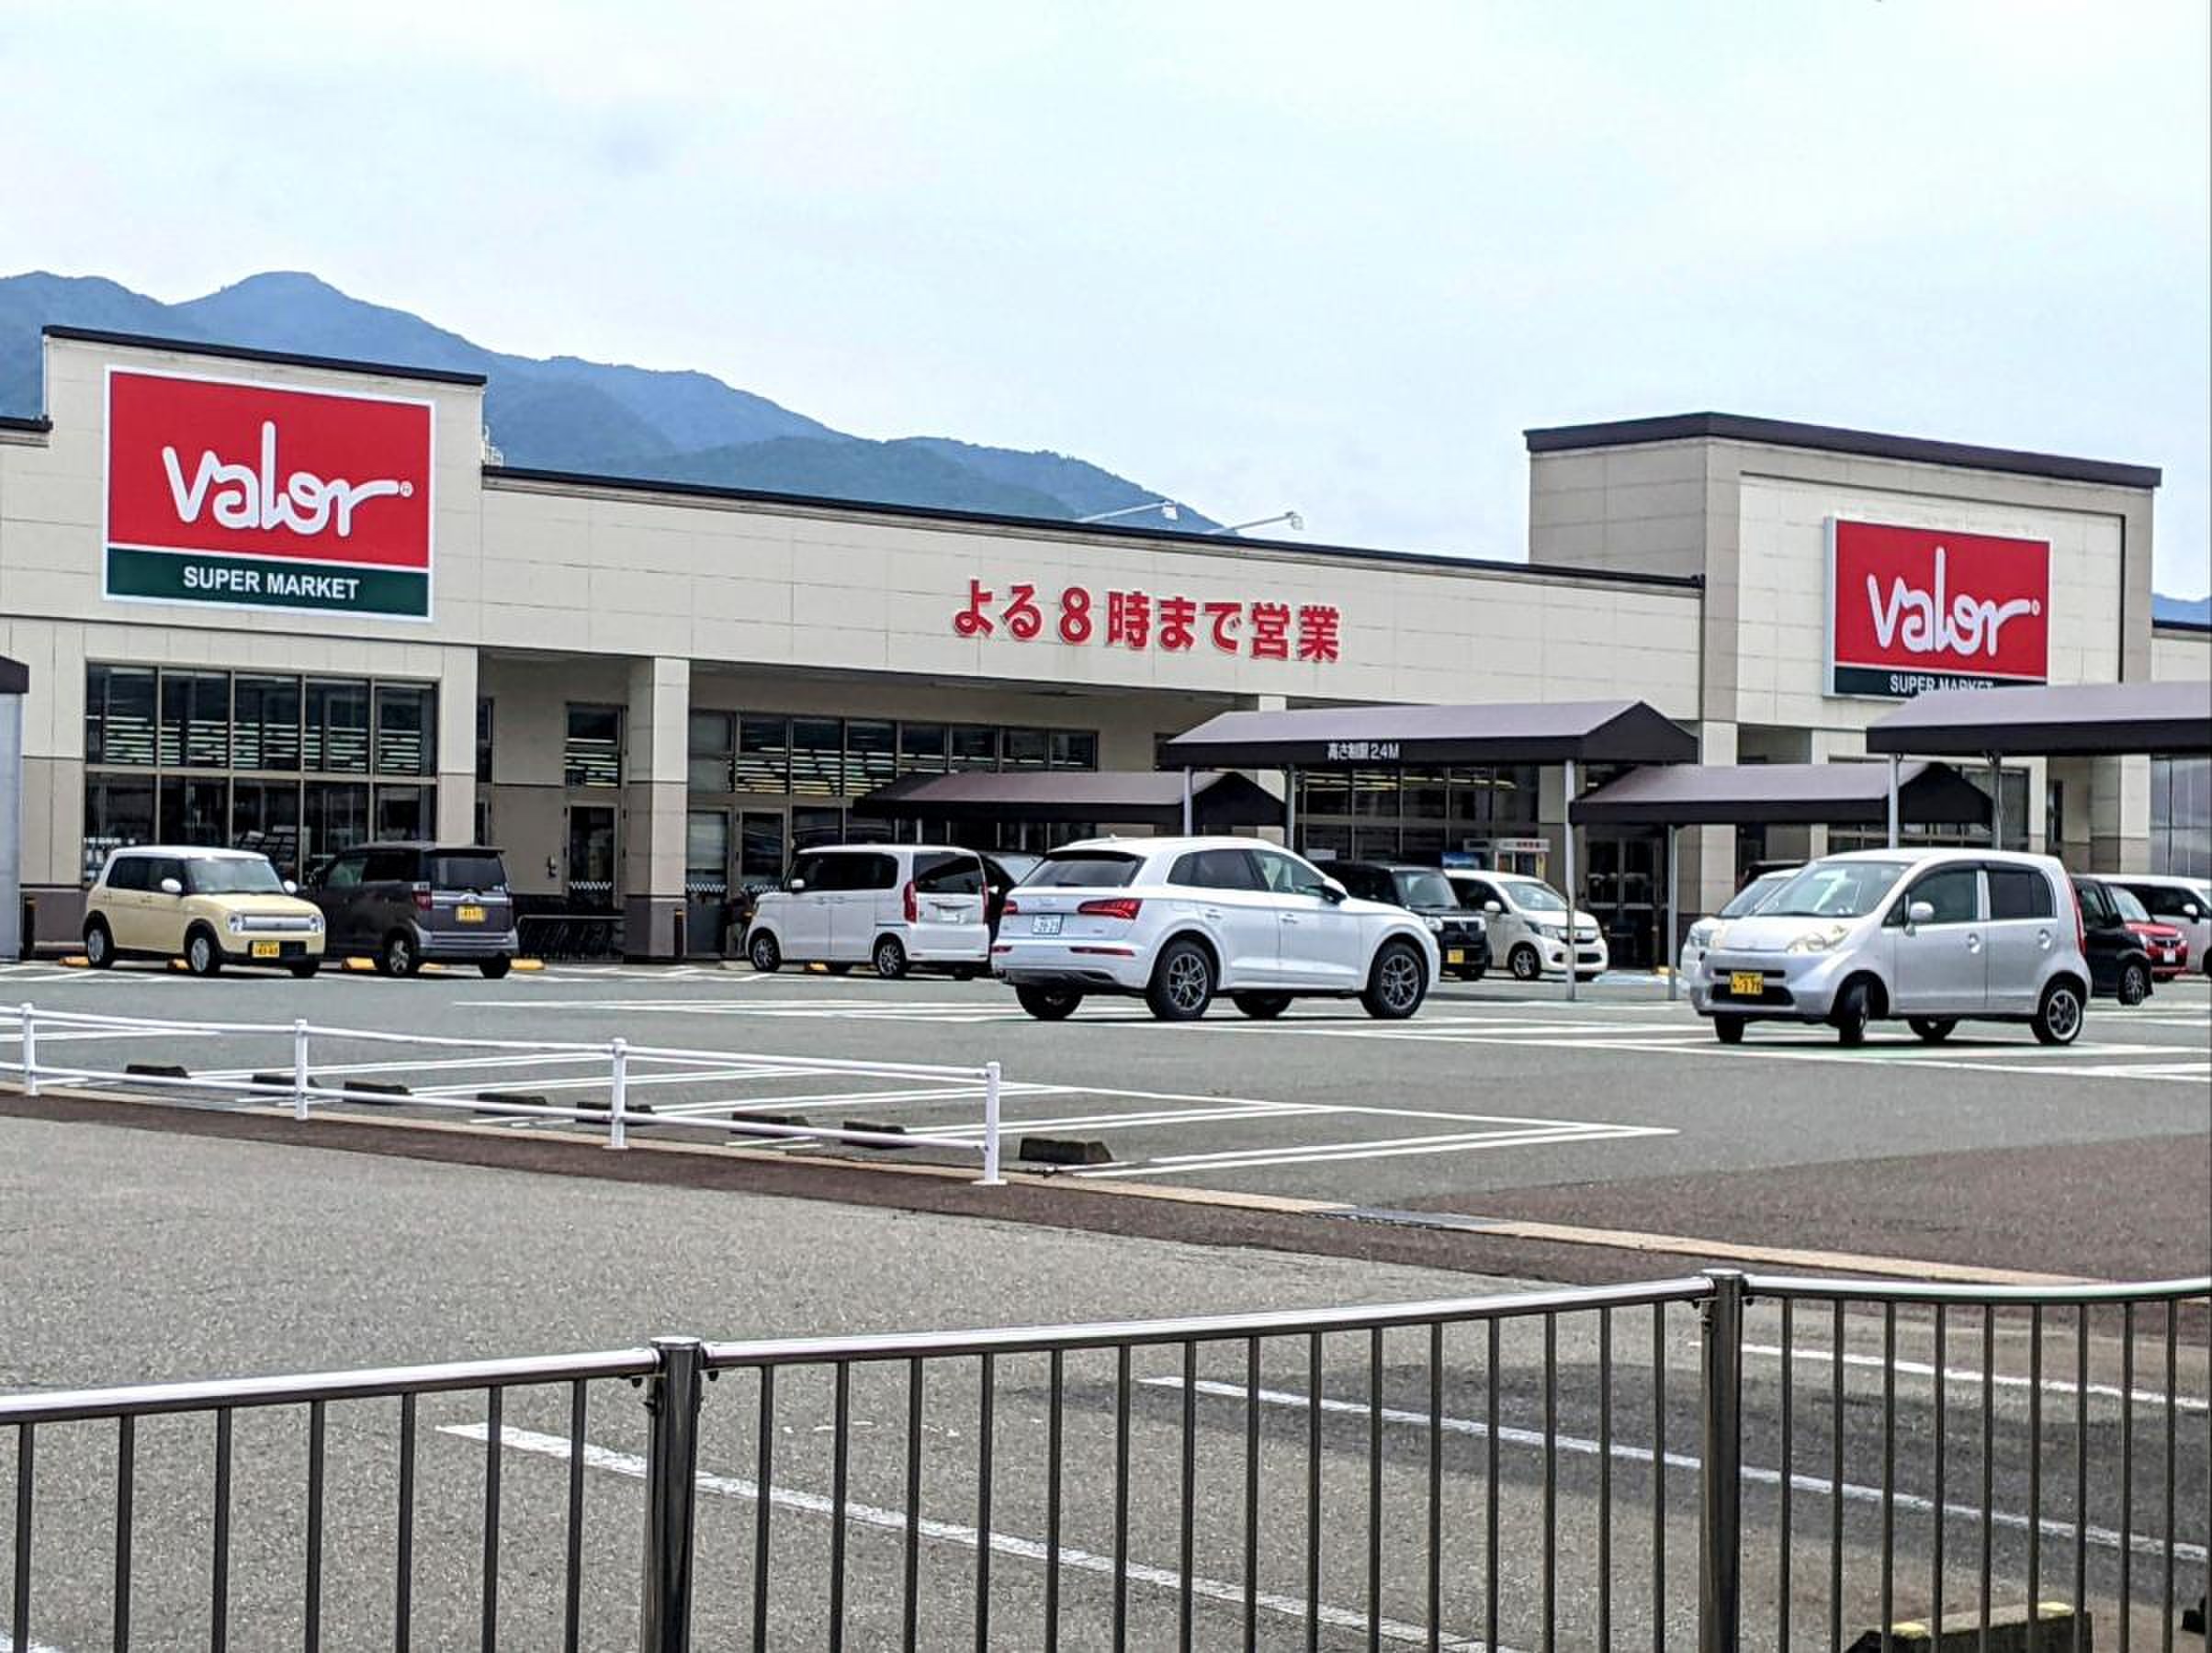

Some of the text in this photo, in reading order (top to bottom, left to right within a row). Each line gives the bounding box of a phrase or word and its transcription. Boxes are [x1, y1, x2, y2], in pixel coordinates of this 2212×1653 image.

[184, 565, 360, 601] SUPER MARKET
[954, 579, 1340, 663] よる8時まで営業
[1890, 673, 1936, 693] SUPER
